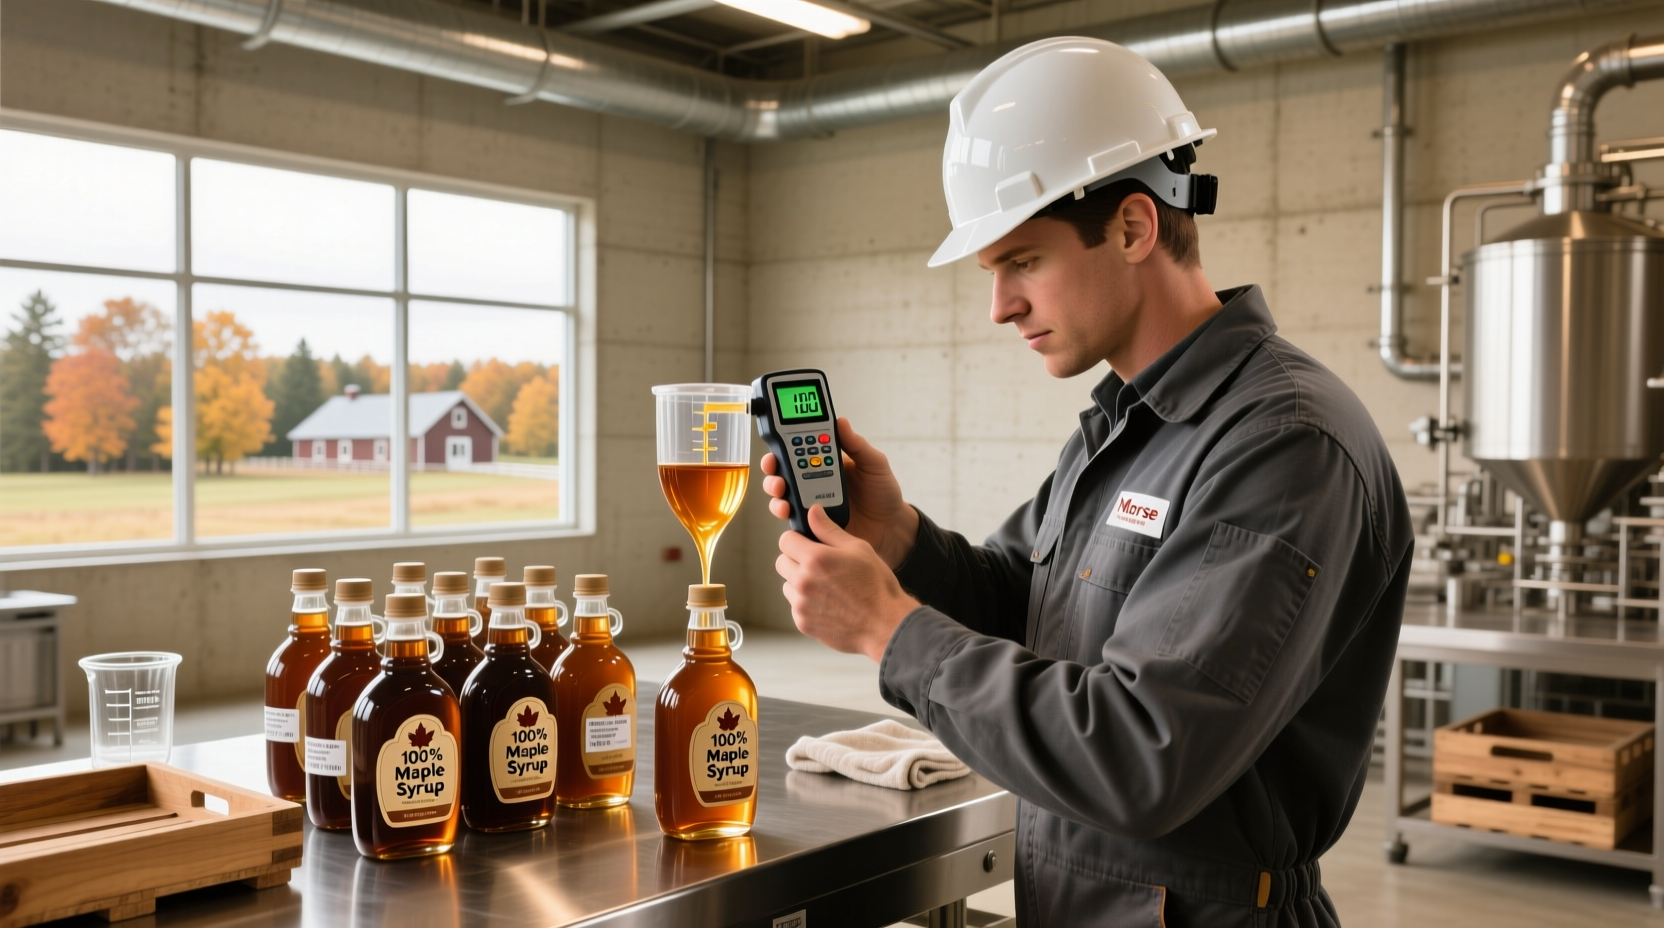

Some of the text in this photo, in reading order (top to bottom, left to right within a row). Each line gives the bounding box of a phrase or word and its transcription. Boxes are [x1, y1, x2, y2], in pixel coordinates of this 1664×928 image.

[794, 391, 819, 414] 100
[1117, 497, 1159, 521] Morse
[511, 727, 548, 744] 100%
[711, 730, 748, 747] 100%
[401, 747, 443, 765] 100%
[506, 743, 549, 760] Maple
[706, 746, 749, 765] Maple
[395, 763, 445, 782] Maple
[507, 759, 548, 777] Syrup
[707, 764, 749, 781] Syrup
[396, 781, 445, 799] Syrup
